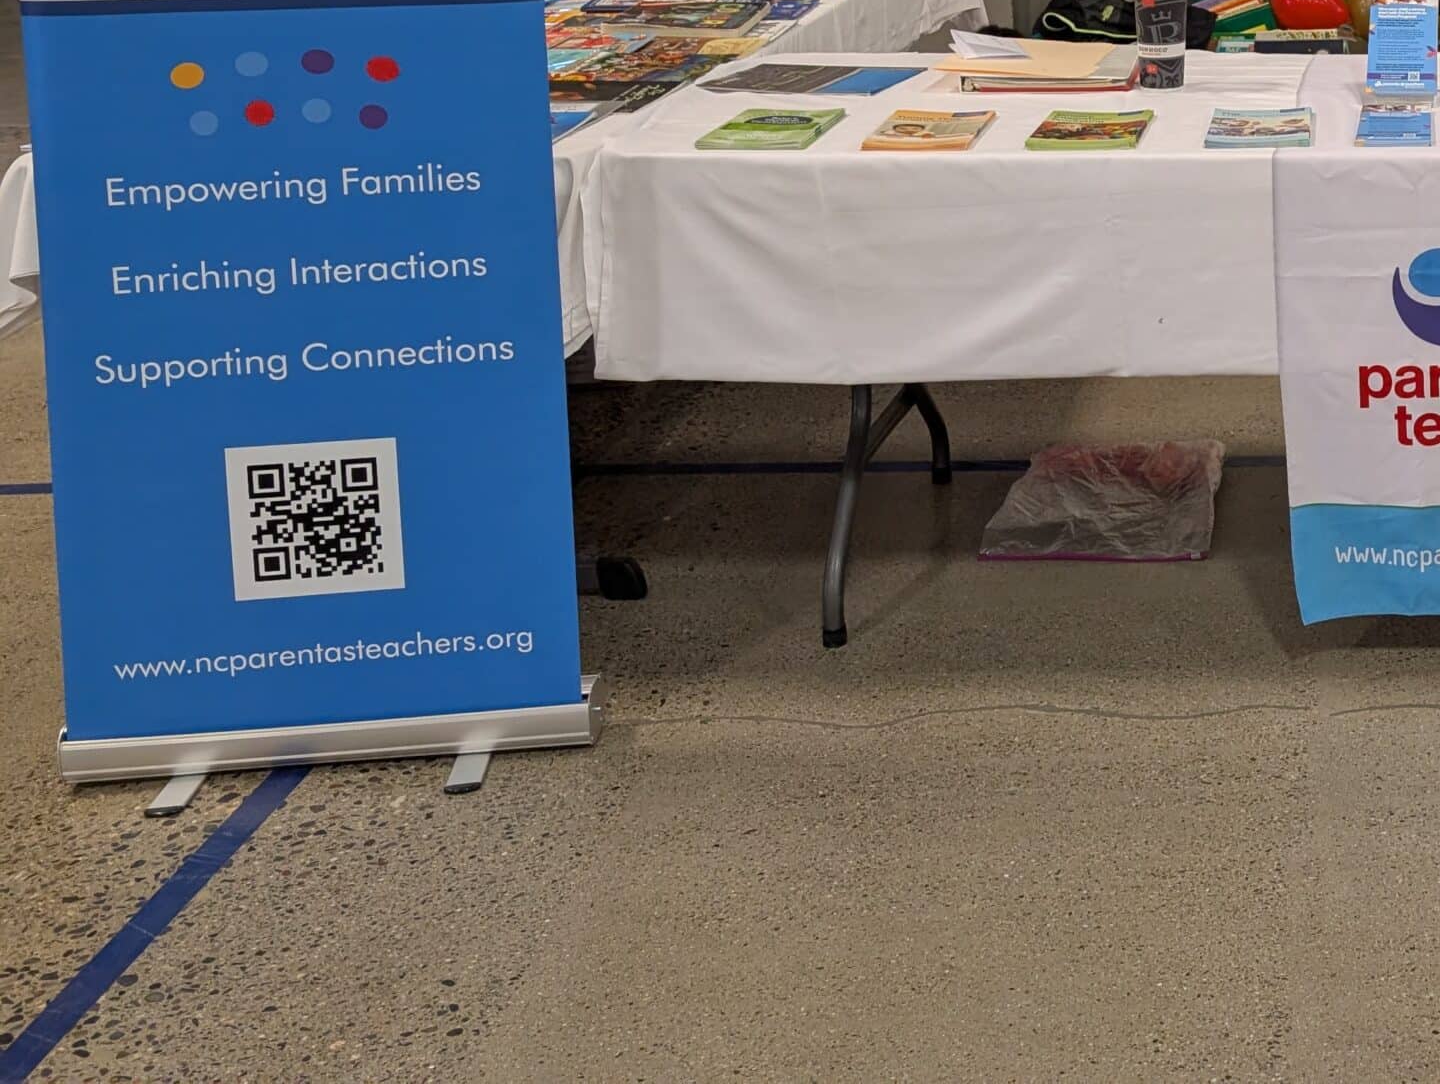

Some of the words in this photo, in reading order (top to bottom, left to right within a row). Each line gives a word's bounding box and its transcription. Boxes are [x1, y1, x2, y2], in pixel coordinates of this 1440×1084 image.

[105, 171, 328, 212] Empowering
[341, 163, 482, 195] Families
[111, 260, 277, 295] Enriching
[290, 251, 488, 285] Interactions
[94, 347, 288, 389] Supporting
[301, 336, 515, 371] Connections
[113, 629, 535, 680] www.ncparentasteachers.org
